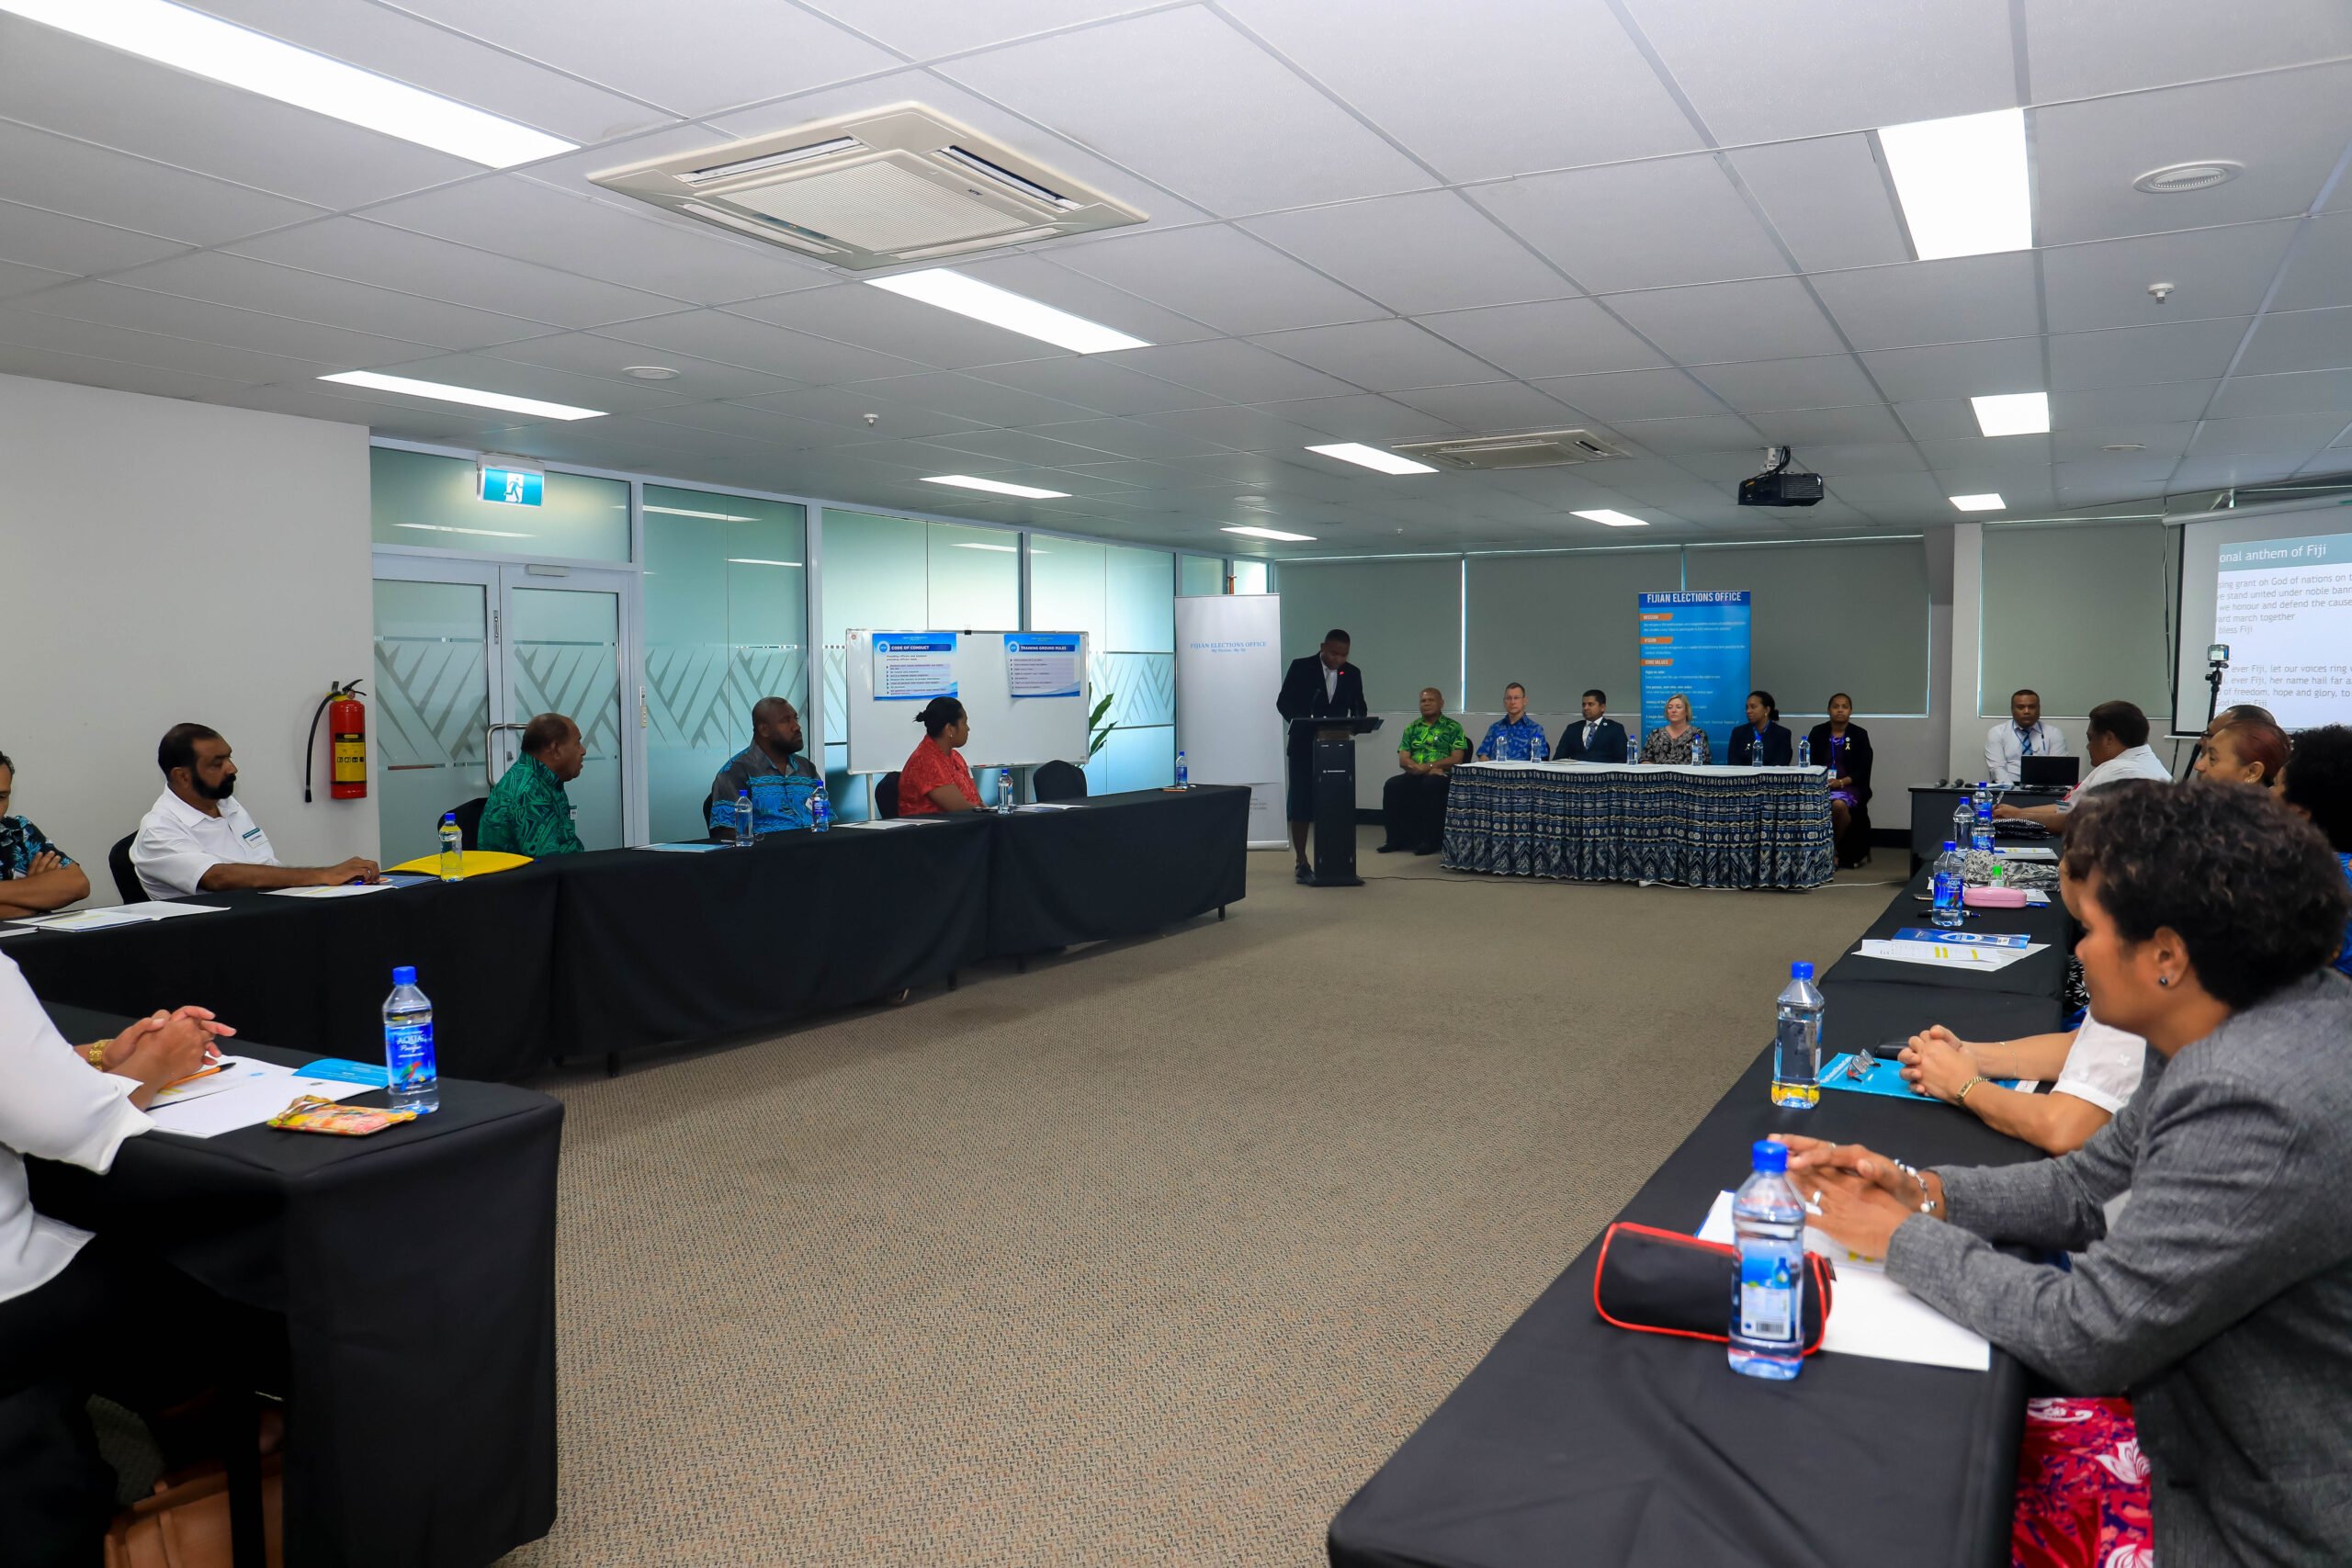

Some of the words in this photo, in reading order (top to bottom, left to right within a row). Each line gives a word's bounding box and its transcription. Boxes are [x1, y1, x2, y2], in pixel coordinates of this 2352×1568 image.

[2220, 551, 2242, 562] onal
[2245, 548, 2288, 560] anthem
[2291, 546, 2304, 557] of
[2307, 544, 2326, 558] Fiji
[2235, 580, 2256, 589] grant
[2271, 577, 2288, 586] God
[2290, 576, 2299, 584] of
[2301, 575, 2333, 583] nations
[2335, 574, 2346, 582] on
[1647, 593, 1670, 603] FIJIAN
[1673, 592, 1713, 603] ELECTIONS
[1715, 592, 1742, 602] OFFICE
[2227, 592, 2248, 600] stand
[2251, 590, 2277, 599] united
[2278, 588, 2302, 597] under
[2305, 587, 2330, 595] noble
[2233, 603, 2259, 611] honour
[2262, 602, 2278, 610] and
[2279, 600, 2309, 609] defend
[2312, 599, 2326, 607] the
[2233, 614, 2257, 622] march
[2260, 613, 2295, 624] together
[2240, 626, 2253, 635] Fiji
[2270, 664, 2282, 673] let
[2301, 665, 2327, 673] voices
[2330, 665, 2347, 674] ring
[2331, 676, 2343, 684] far
[2223, 687, 2232, 695] of
[2273, 688, 2293, 697] hope
[396, 1035, 425, 1044] AQUA
